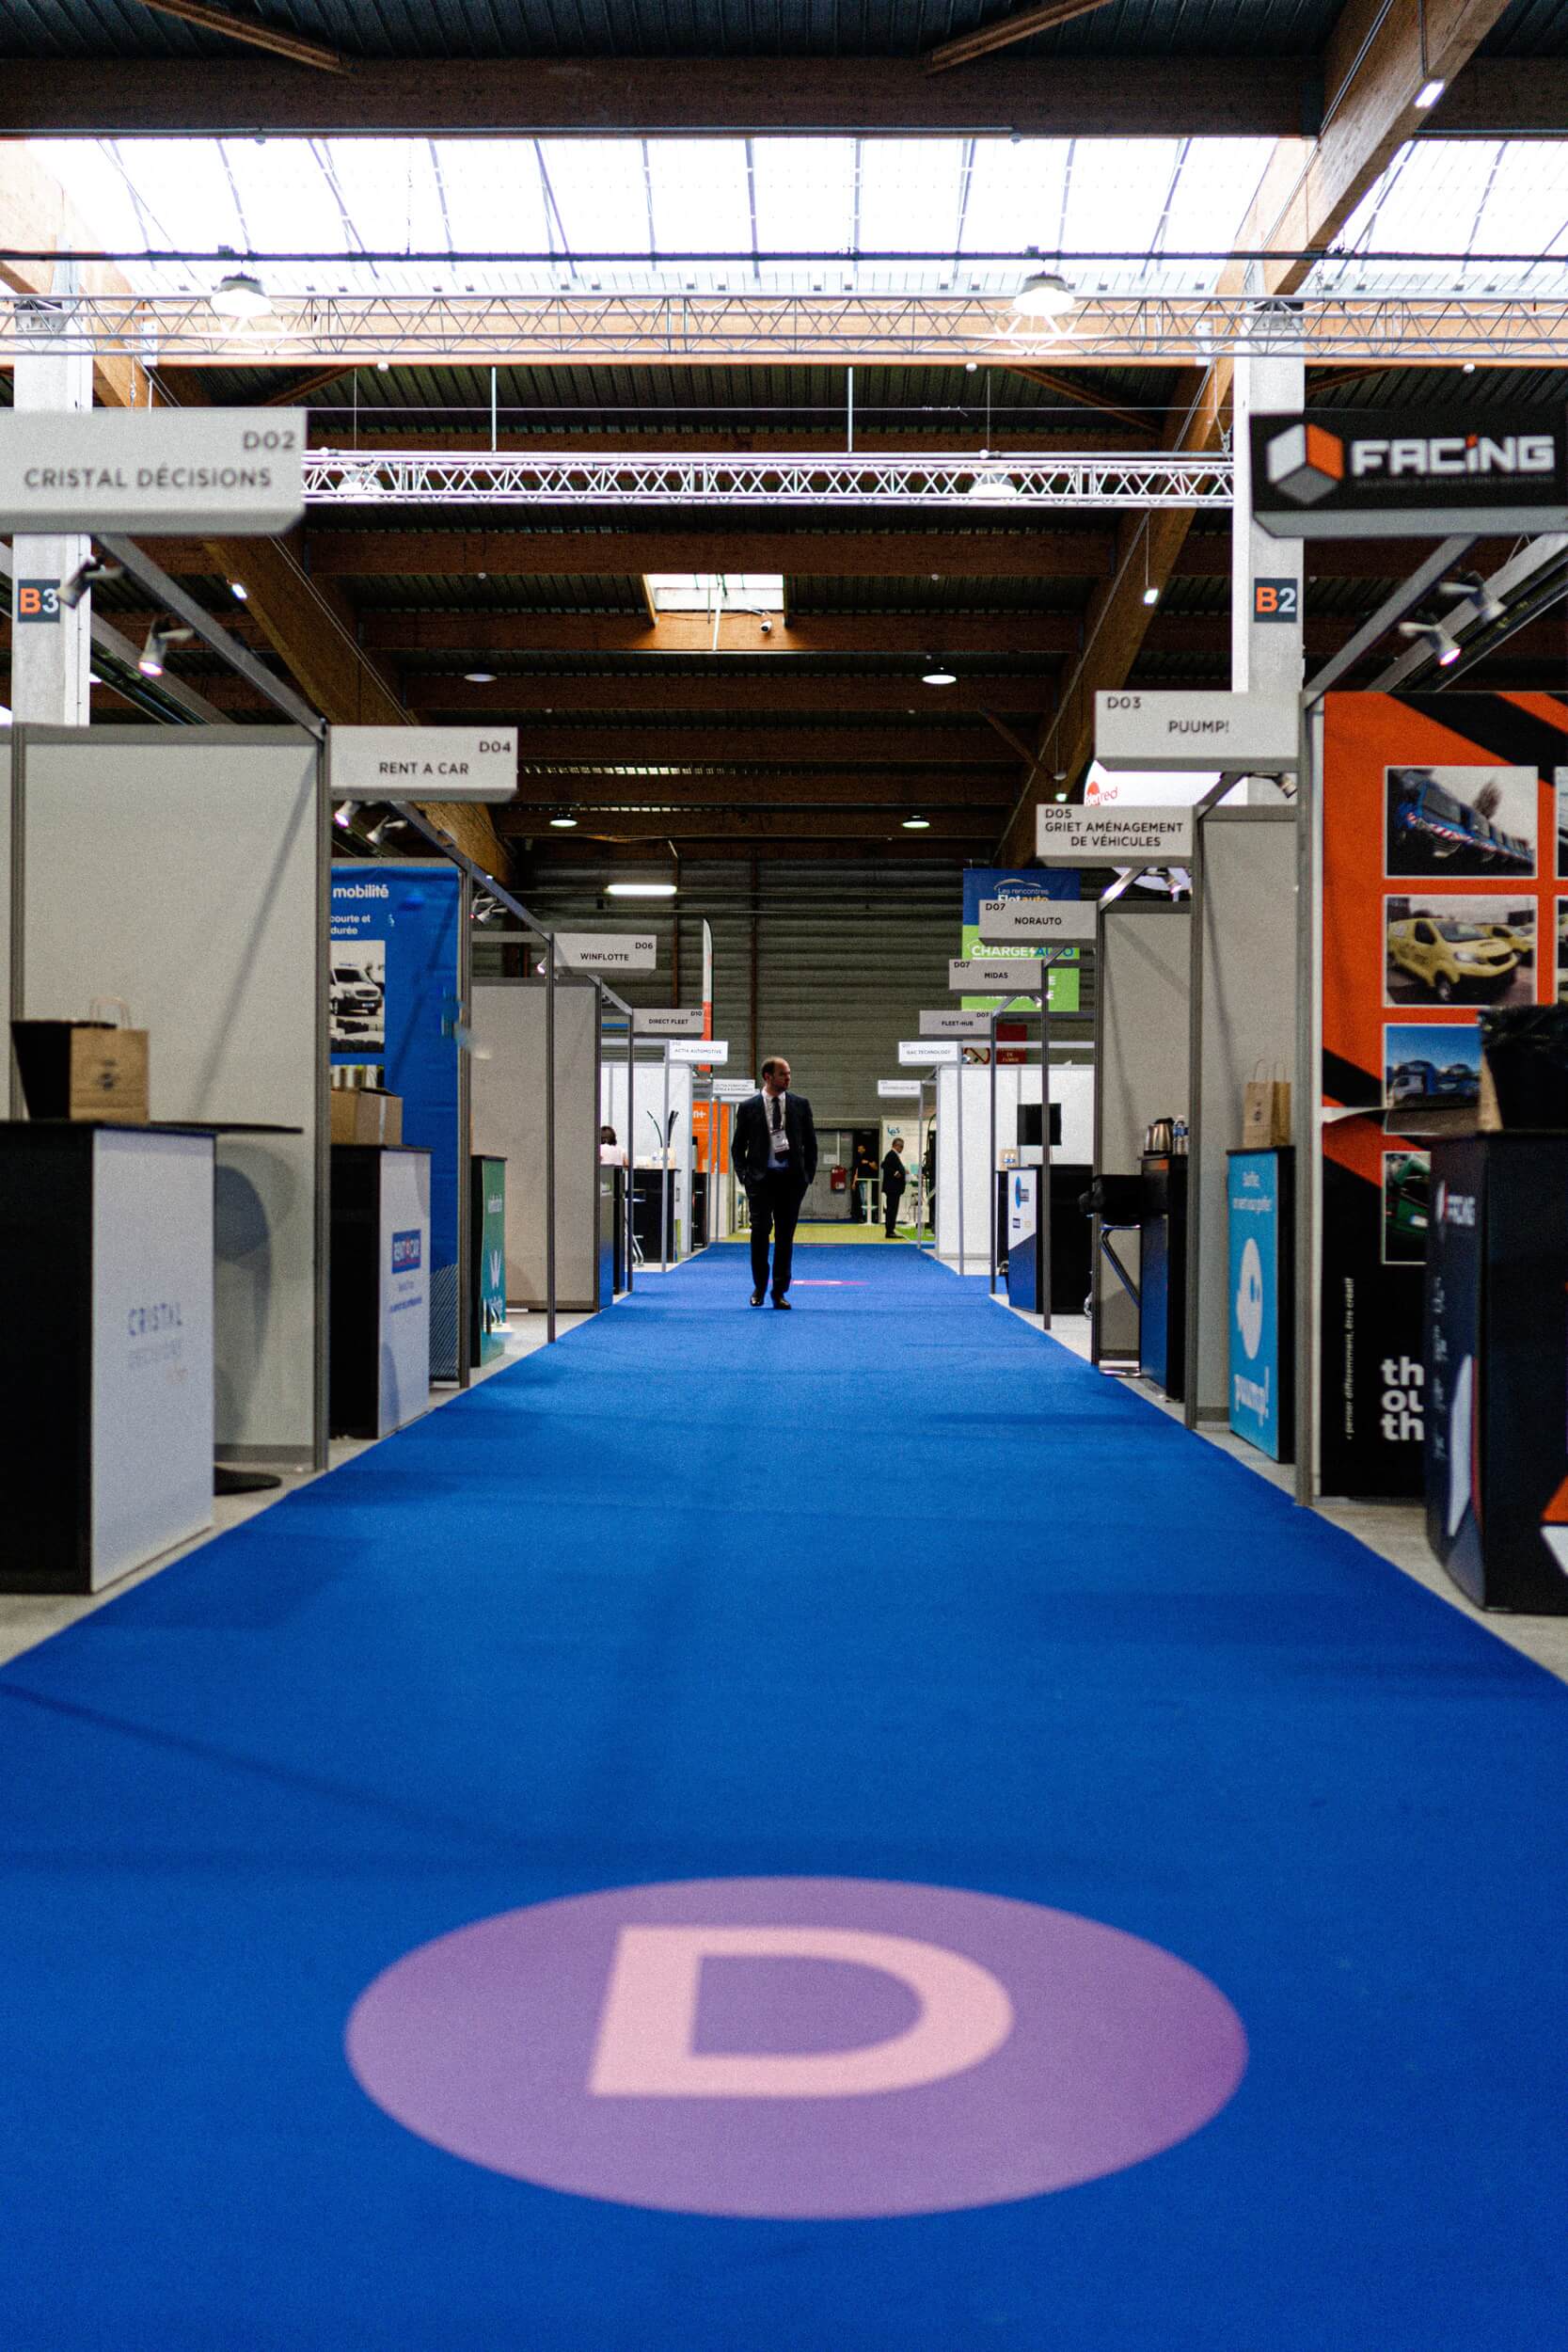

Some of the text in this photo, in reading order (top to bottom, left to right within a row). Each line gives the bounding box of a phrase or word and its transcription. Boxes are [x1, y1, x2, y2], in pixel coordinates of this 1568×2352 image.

[243, 430, 296, 450] D02
[24, 463, 272, 488] CRISTAL DÉCISIONS
[19, 588, 60, 614] B3
[1255, 587, 1297, 612] B2
[1107, 696, 1142, 709] D03
[1168, 720, 1230, 733] PUUMP!
[479, 740, 512, 753] D04
[379, 762, 469, 774] RENT A CAR
[1045, 808, 1072, 818] D05
[1045, 819, 1183, 833] GRIET AMÉNAGEMENT
[1070, 834, 1161, 847] DE VÉHICULES
[332, 883, 389, 898] mobilité
[361, 914, 372, 923] et
[1014, 916, 1062, 926] NORAUTO
[330, 925, 358, 935] durée
[580, 952, 629, 961] WINFLOTTE
[587, 1924, 1015, 2099] D
